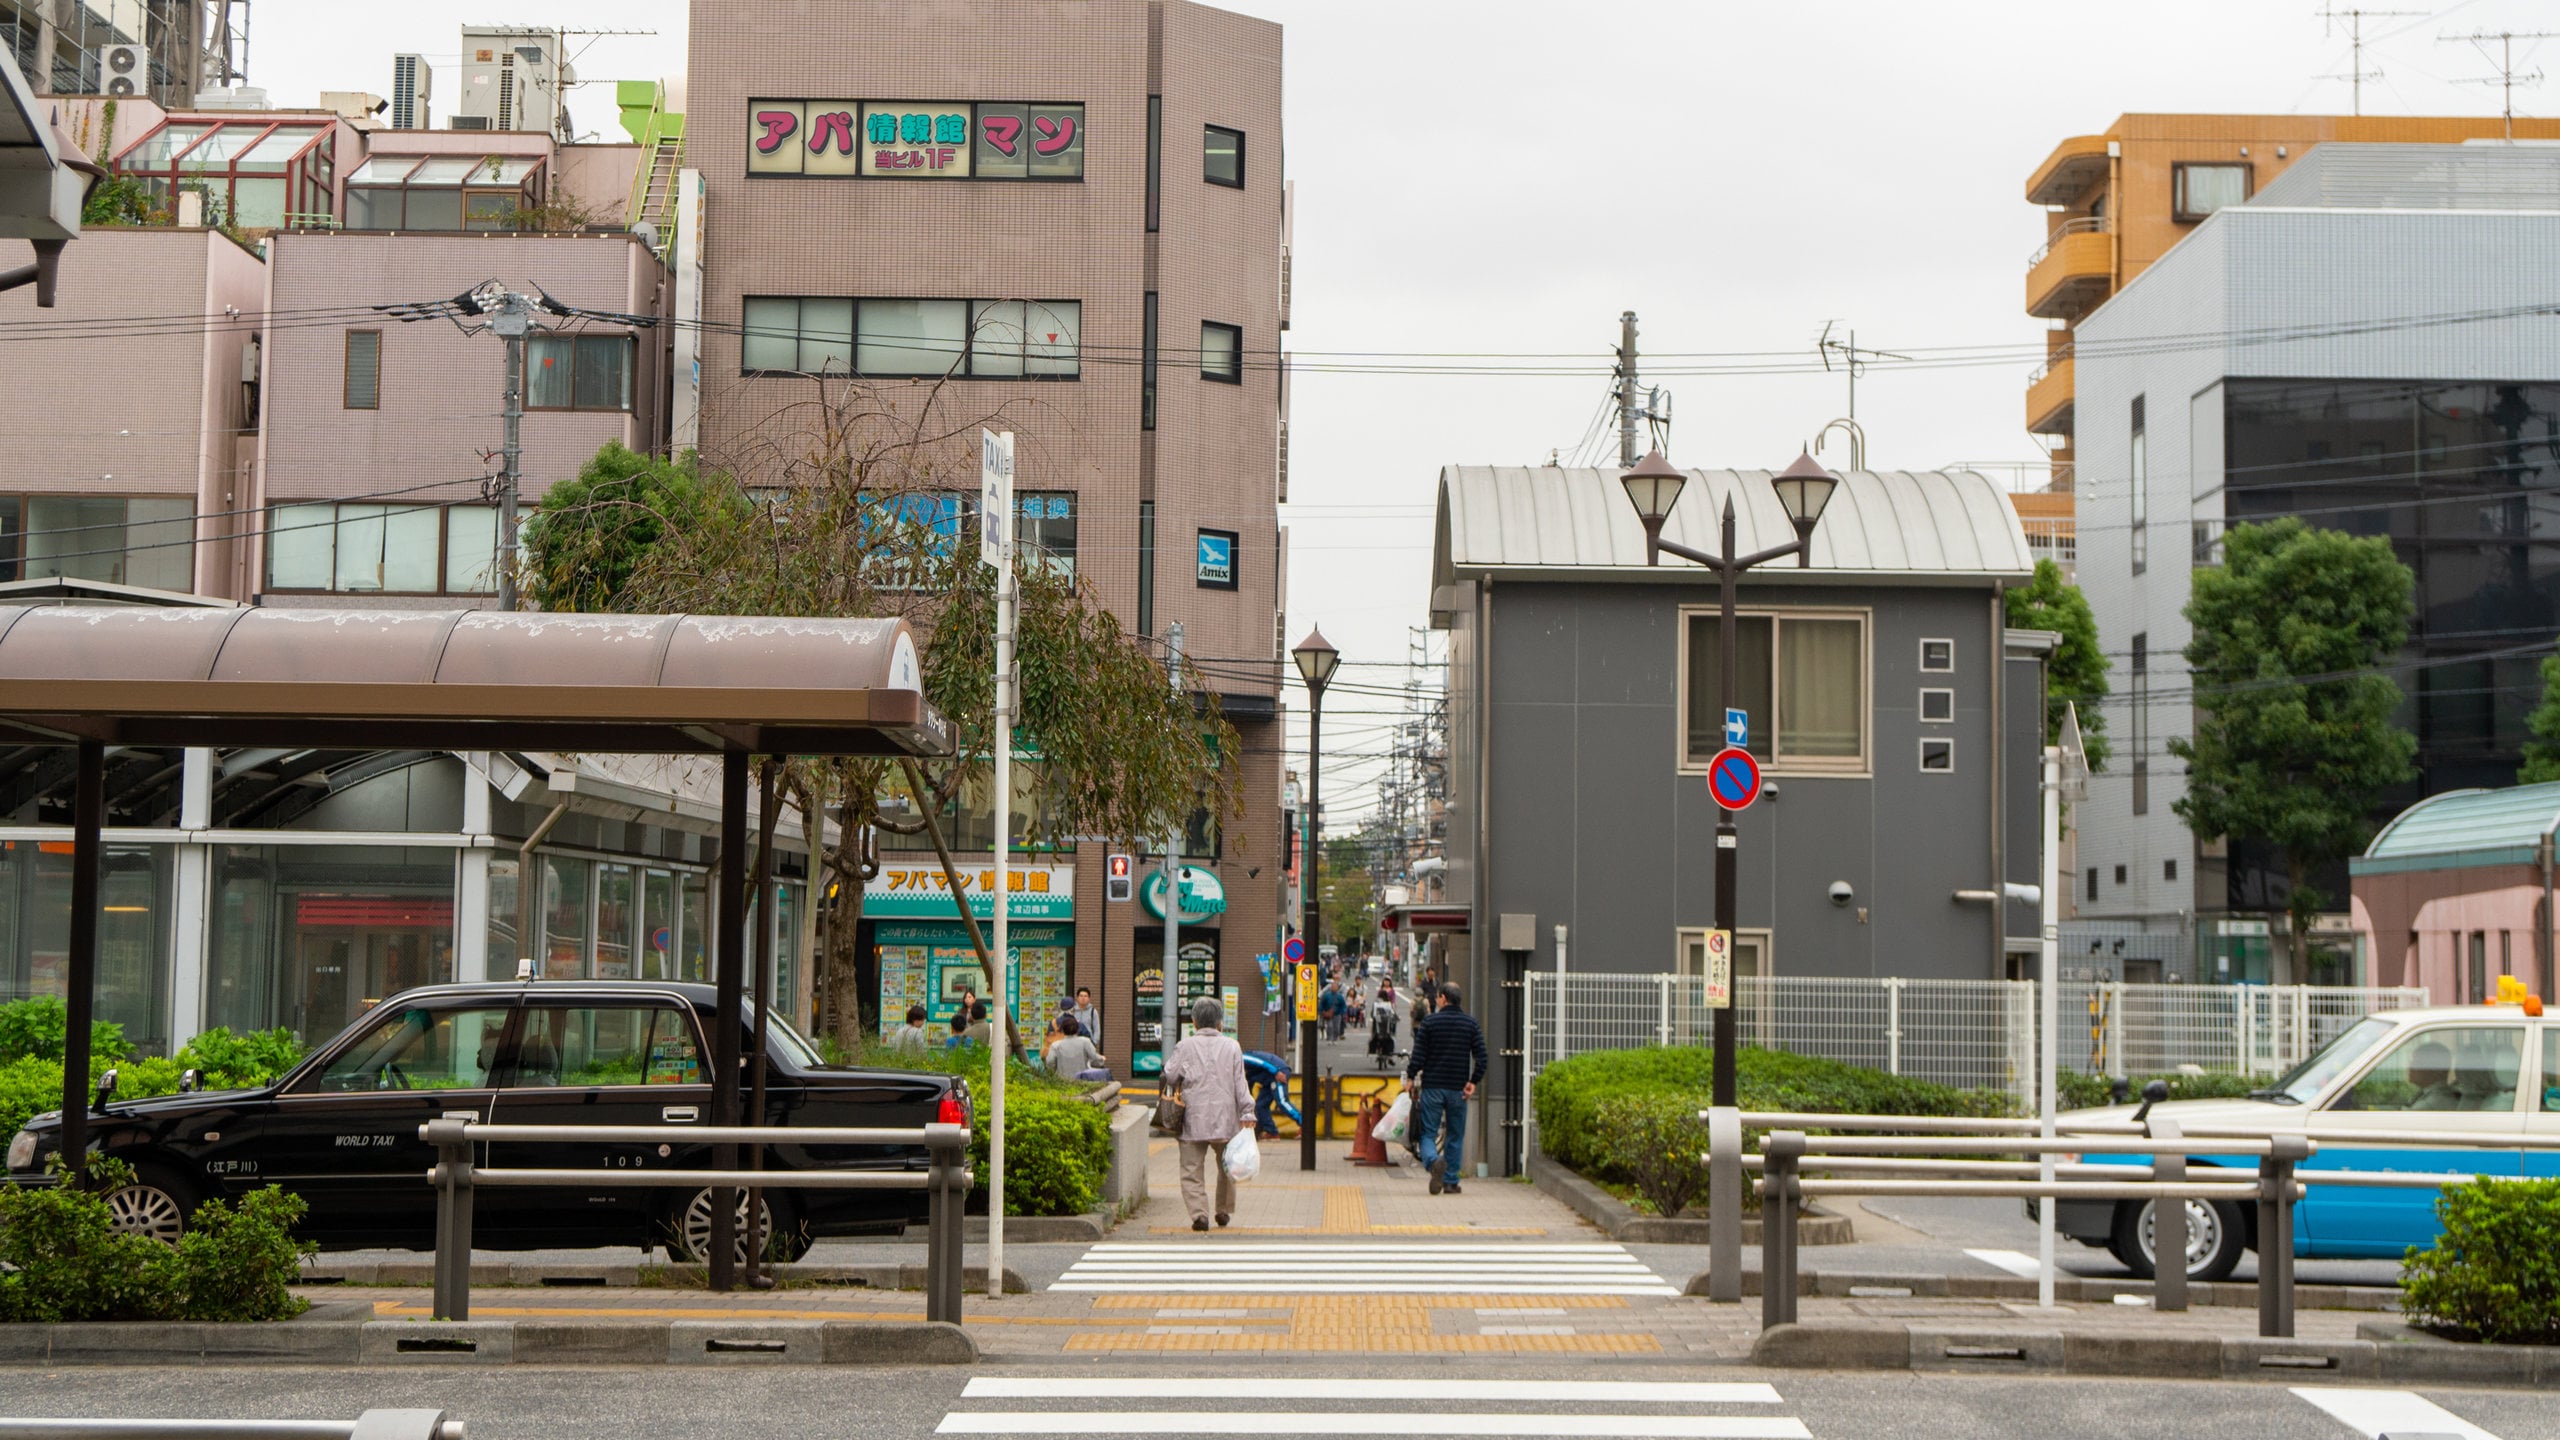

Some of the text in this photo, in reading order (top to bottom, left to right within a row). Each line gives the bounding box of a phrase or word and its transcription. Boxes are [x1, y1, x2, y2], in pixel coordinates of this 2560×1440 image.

[867, 113, 967, 145] 情報館
[875, 149, 956, 170] 当ビル1F
[984, 438, 1004, 479] TAXI
[1200, 565, 1228, 578] Amix
[979, 870, 1049, 892] 情報館
[335, 1135, 395, 1146] WORLD TAXI
